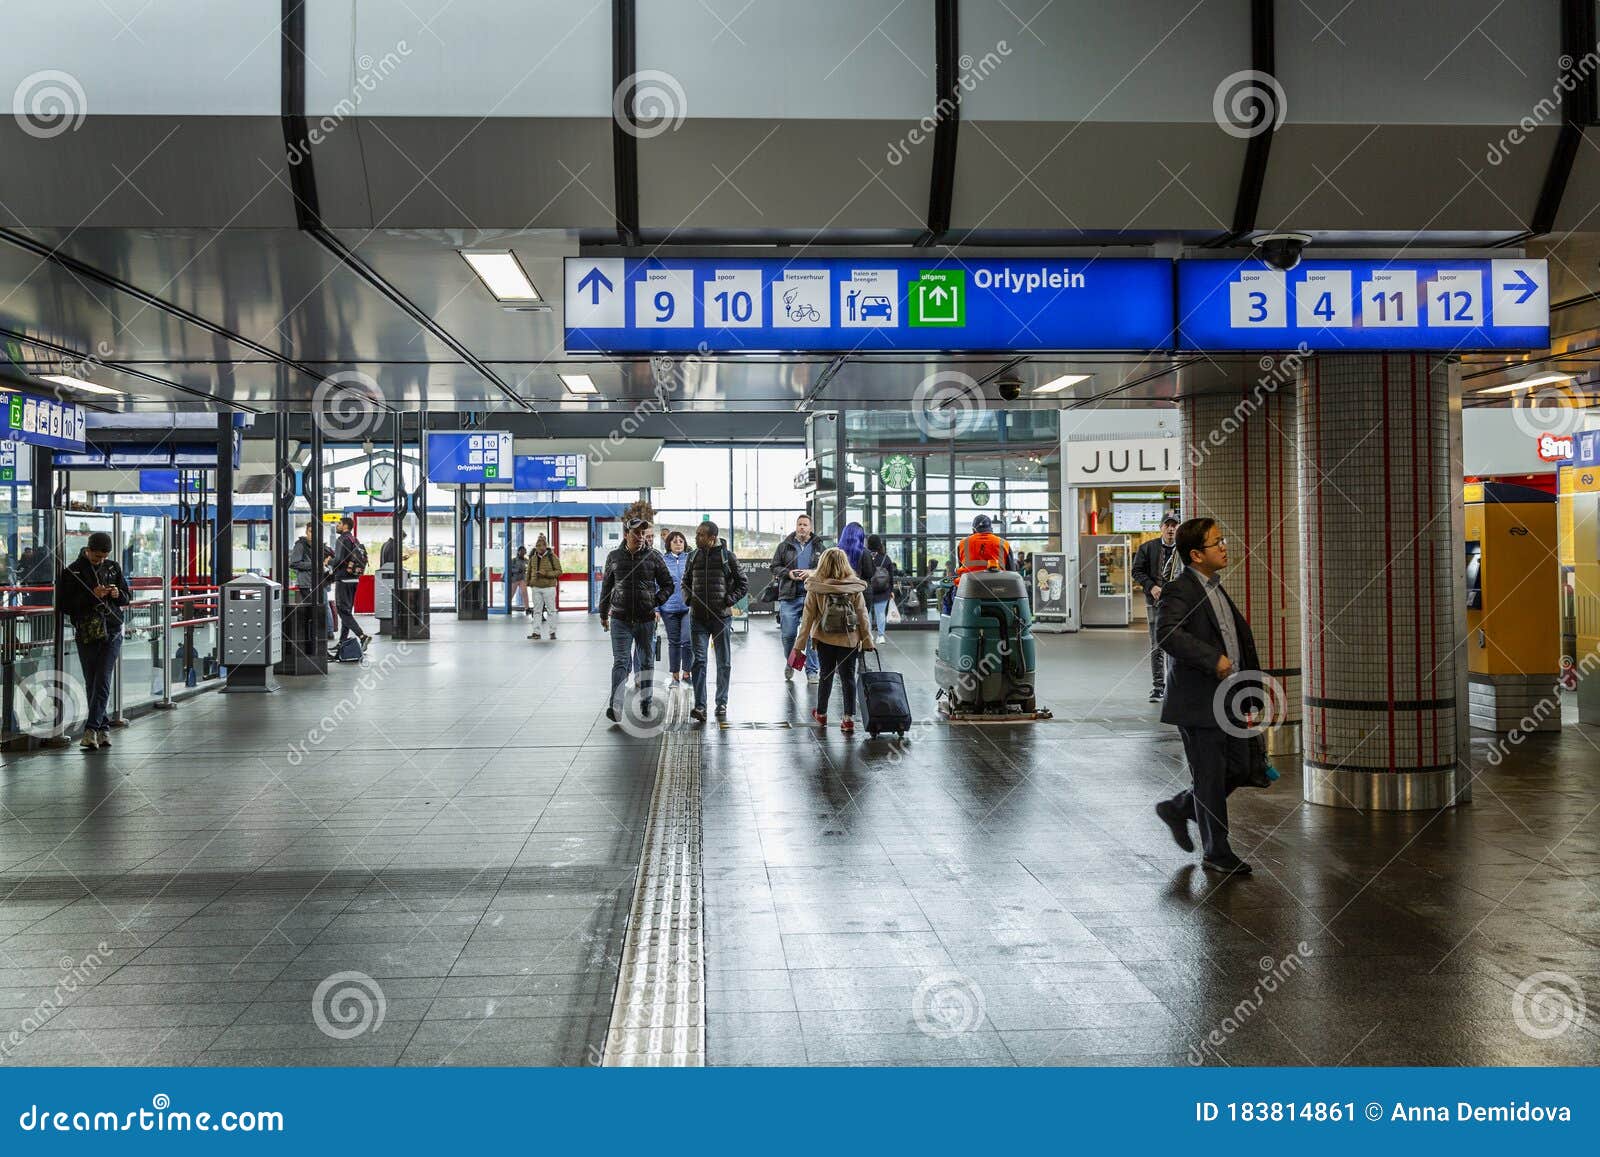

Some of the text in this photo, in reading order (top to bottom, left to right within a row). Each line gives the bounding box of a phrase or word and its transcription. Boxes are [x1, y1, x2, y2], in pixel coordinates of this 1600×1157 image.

[974, 267, 1086, 293] Orlyplein
[654, 291, 675, 322] 9
[714, 291, 753, 322] 10
[1248, 291, 1268, 322] 3
[1313, 291, 1336, 321] 4
[1371, 291, 1404, 321] 11
[1436, 291, 1474, 321] 12
[1082, 448, 1182, 474] JULI
